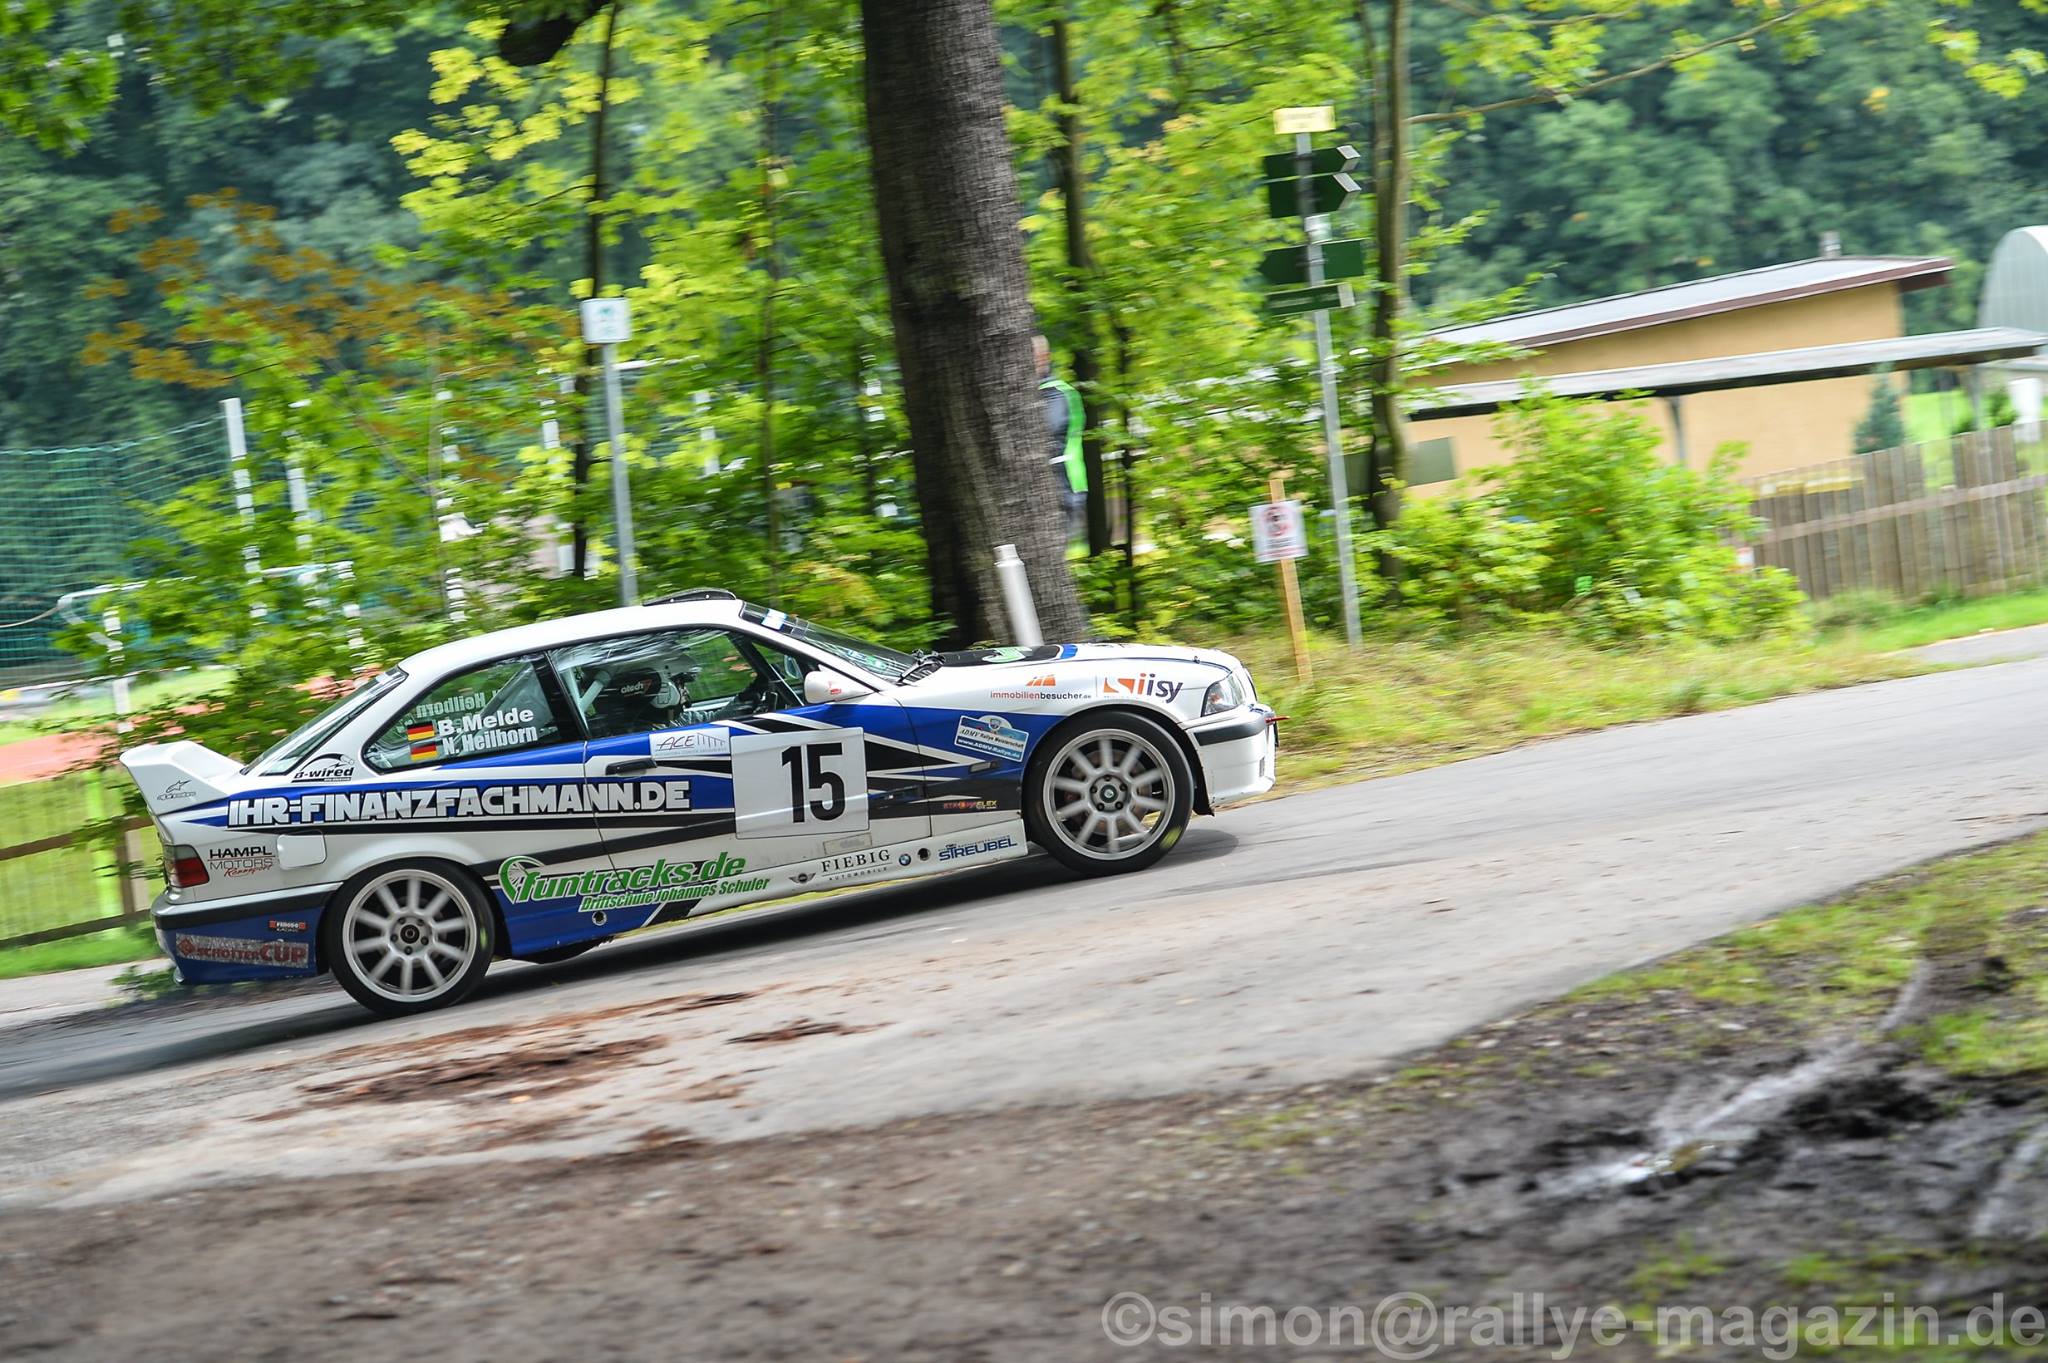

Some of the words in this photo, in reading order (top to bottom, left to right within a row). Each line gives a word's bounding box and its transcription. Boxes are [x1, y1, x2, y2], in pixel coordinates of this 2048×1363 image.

[442, 737, 460, 755] N.
[462, 726, 538, 751] Heilborn
[781, 742, 846, 823] 15
[227, 781, 690, 828] IHR-FINANZFACHMANN.DE
[209, 846, 273, 859] HAMPL
[821, 849, 891, 872] FIEBIG
[938, 837, 1018, 862] STREUBEL
[210, 858, 274, 870] MOTORS
[511, 851, 747, 902] funtracks.de
[828, 867, 888, 881] AUTOMOBILE
[579, 891, 653, 911] Driftschule
[652, 882, 717, 904] Johannes
[718, 877, 771, 895] Schuler
